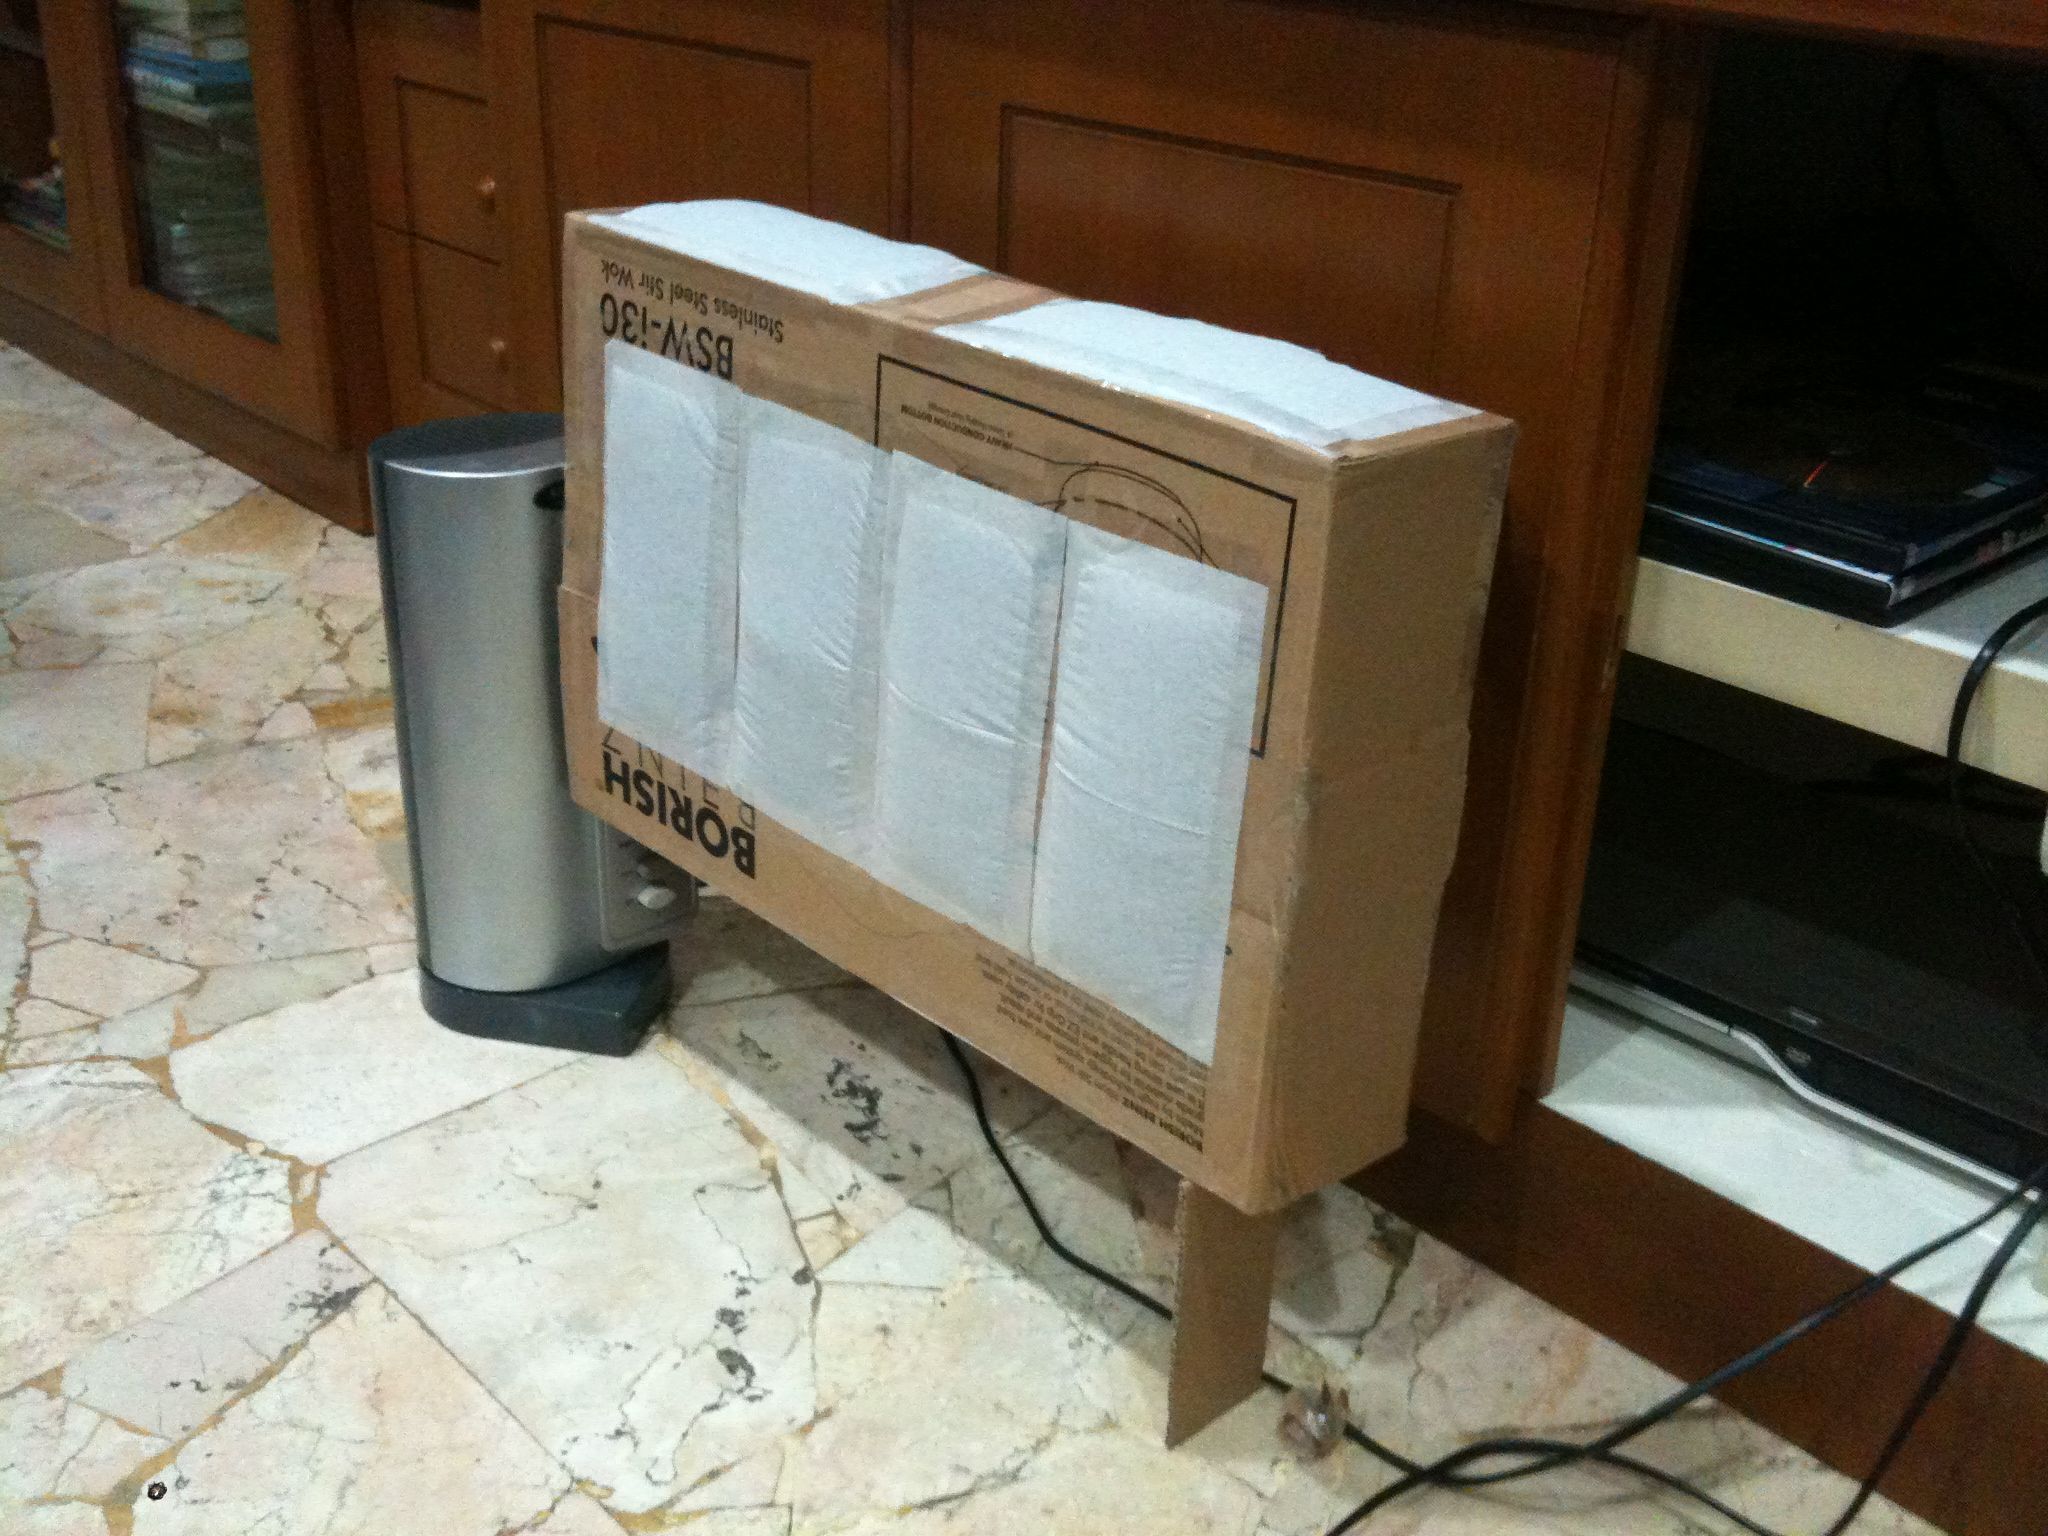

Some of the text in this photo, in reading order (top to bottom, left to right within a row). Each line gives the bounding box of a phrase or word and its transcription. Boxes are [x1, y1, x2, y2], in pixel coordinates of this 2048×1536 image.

[601, 259, 784, 344] Stainless Steel Stir Wok
[602, 750, 756, 881] BORISH
